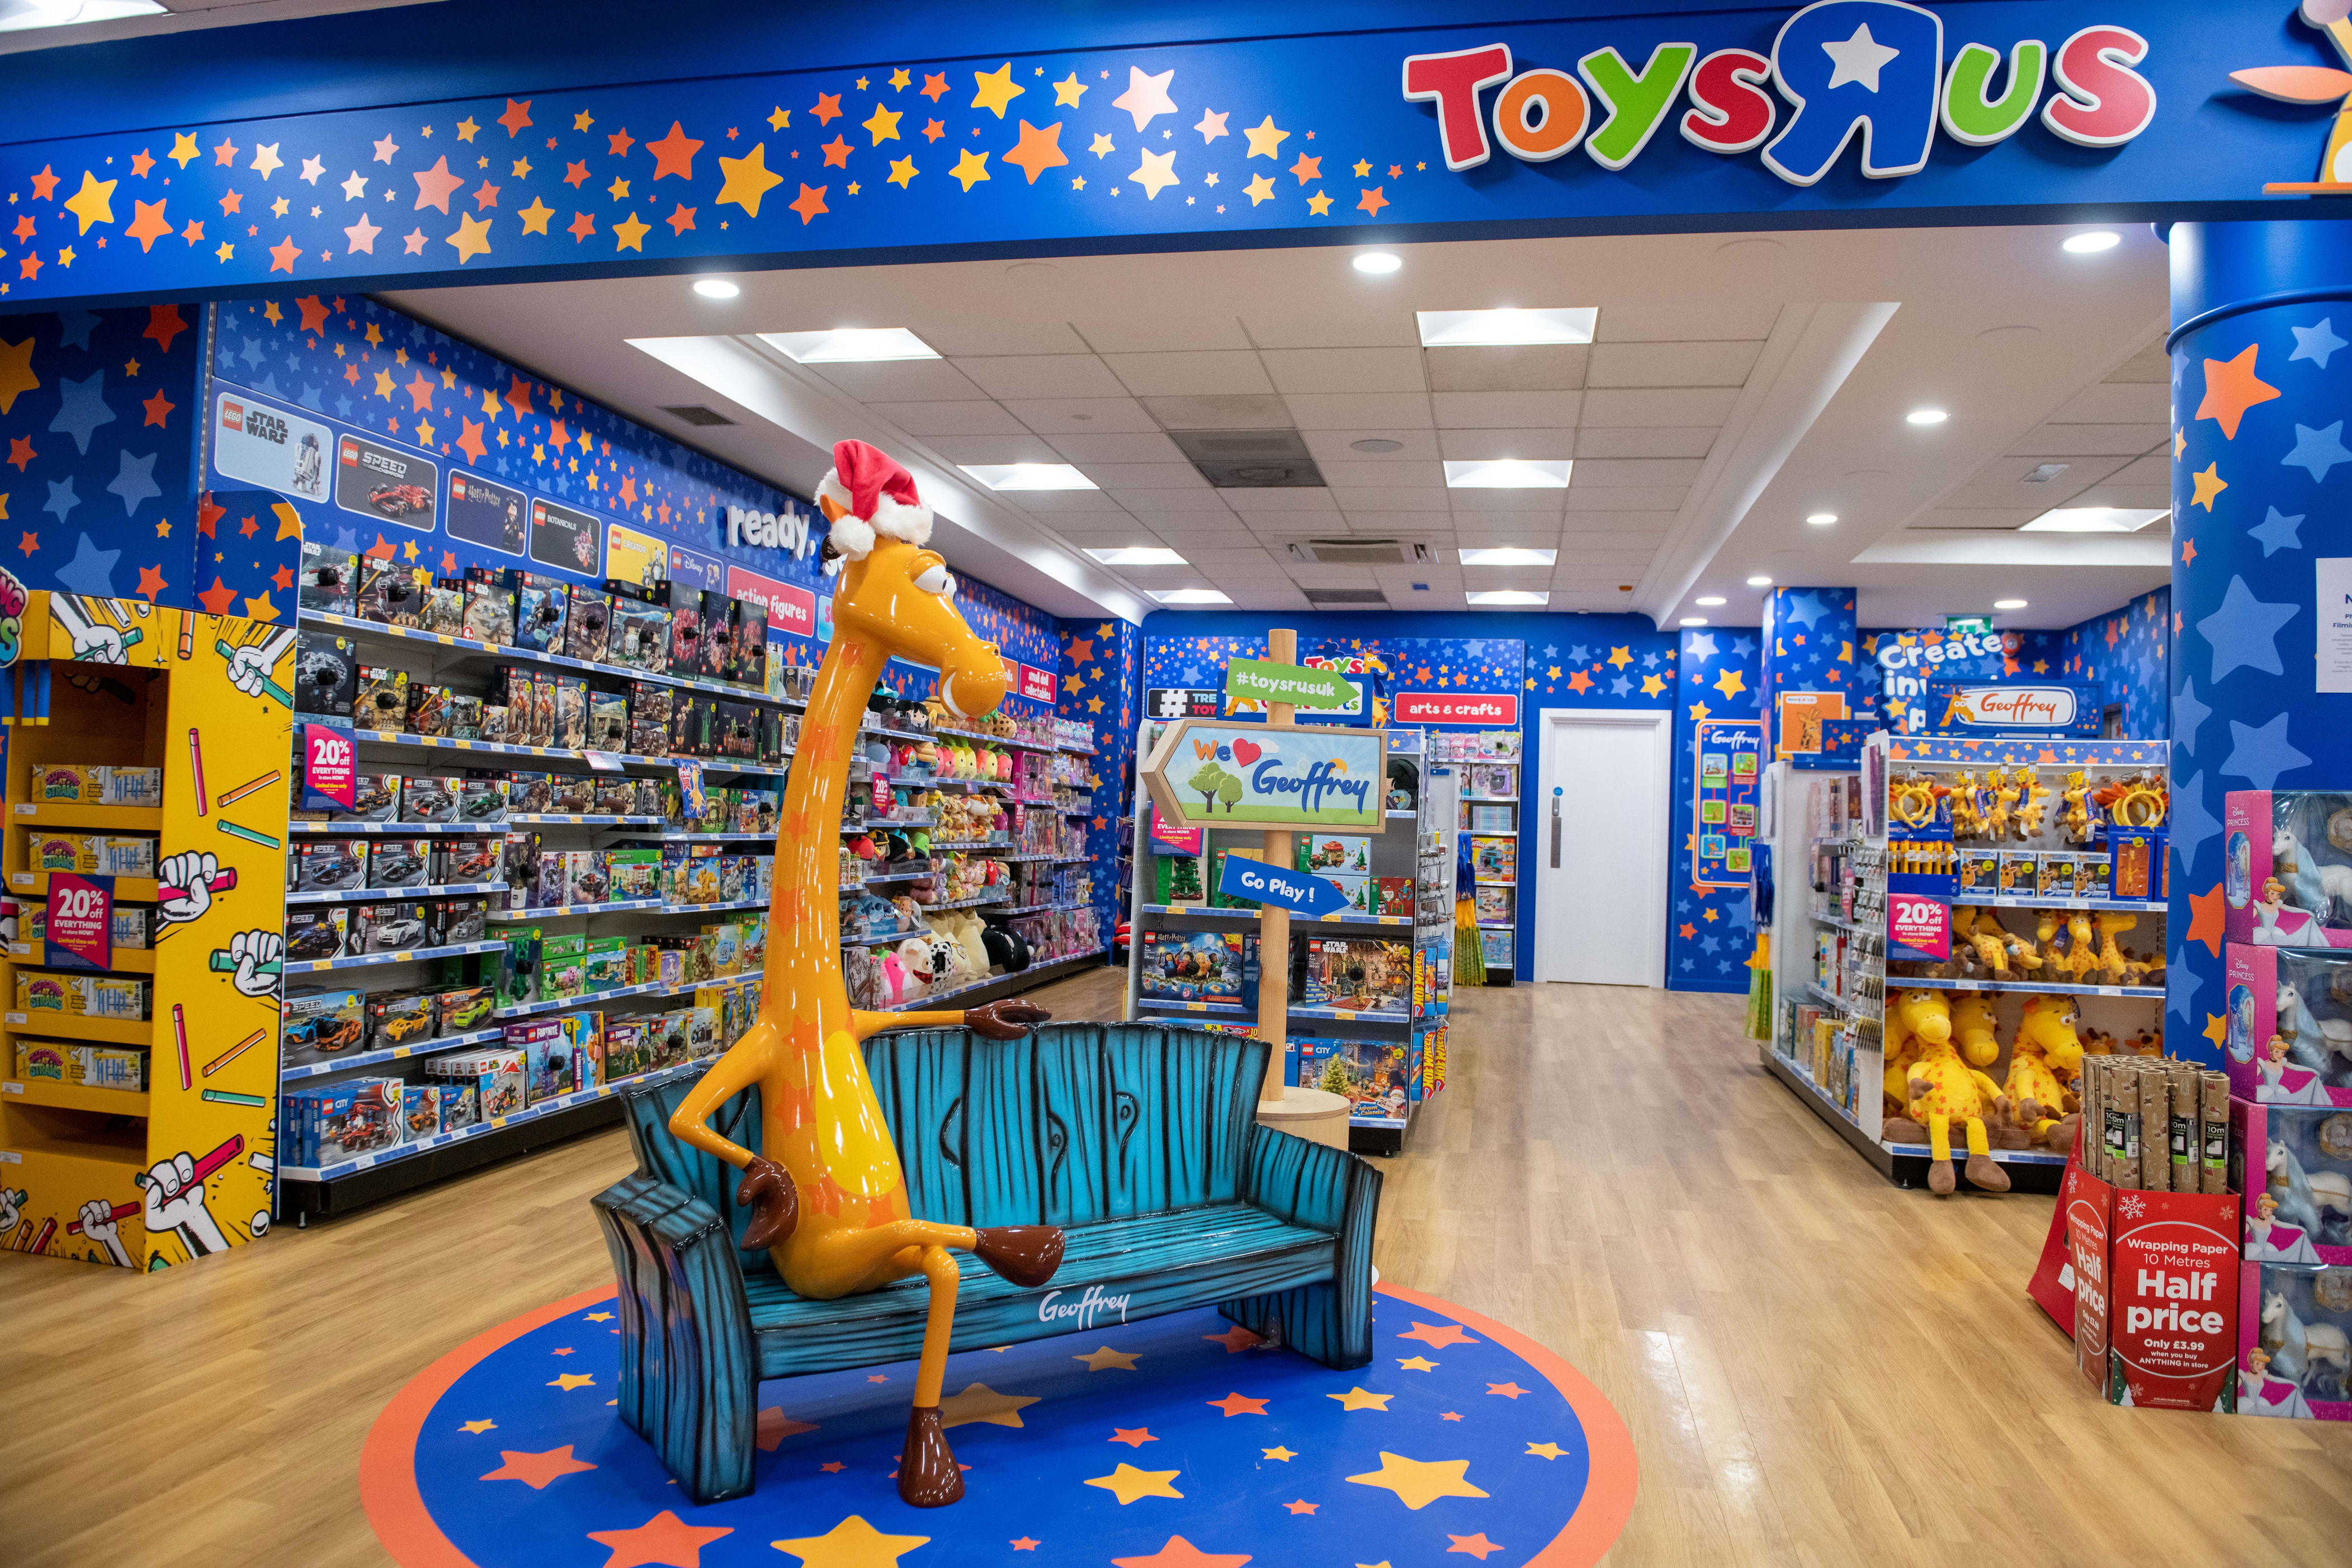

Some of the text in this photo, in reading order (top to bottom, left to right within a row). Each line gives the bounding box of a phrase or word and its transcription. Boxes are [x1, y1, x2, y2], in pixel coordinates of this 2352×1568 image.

[223, 408, 242, 424] LEGO
[247, 410, 288, 434] STAR
[246, 423, 288, 445] WARS
[342, 448, 358, 460] LEGO
[362, 451, 407, 475] SPEED
[379, 467, 405, 479] CHAMPIONS
[453, 483, 465, 494] LEGO
[467, 484, 502, 507] Harry Potter
[534, 510, 577, 531] LEGO BOTANICALS
[612, 536, 646, 554] LEGO CREATOR
[771, 596, 806, 622] figures
[1878, 632, 2004, 669] Create
[1028, 671, 1049, 686] small doll
[1236, 672, 1335, 697] #toysrusuk
[1025, 683, 1051, 701] collectables
[1410, 702, 1502, 716] arts & crafts
[1981, 693, 2057, 722] Geoffrey
[1711, 730, 1760, 750] Geoffrey
[314, 739, 350, 766] 20%
[339, 756, 350, 766] off
[1193, 739, 1369, 815] We Geoffrey
[45, 784, 79, 800] STRAWS
[2232, 806, 2245, 817] Disney
[2227, 818, 2250, 827] PRINCESS
[1241, 871, 1264, 889] Go
[1269, 879, 1305, 903] Play
[56, 888, 103, 918] 20%
[89, 908, 103, 919] off
[1896, 902, 1942, 924] 20%
[1929, 916, 1942, 924] off
[54, 919, 102, 930] EVERYTHING
[1158, 934, 1172, 943] Harry
[1171, 933, 1186, 942] Potter
[2235, 958, 2249, 970] Disney
[2229, 969, 2254, 981] PRINCESS
[30, 994, 63, 1010] STRAWS
[292, 999, 322, 1010] SPEED
[537, 1024, 558, 1039] FORTNITE
[615, 1028, 631, 1038] FORTNITE
[30, 1062, 62, 1079] STRAWS
[336, 1098, 348, 1109] CITY
[2171, 1121, 2186, 1130] 10m
[2070, 1212, 2104, 1240] Wrapping Paper
[2075, 1228, 2098, 1251] 10 Metres
[2127, 1238, 2228, 1254] Wrapping Paper
[2075, 1243, 2101, 1283] Half
[2143, 1253, 2210, 1268] 10 Metres
[2137, 1269, 2217, 1301] Half
[2077, 1276, 2105, 1317] price
[1038, 1284, 1130, 1330] Geoffrey
[2127, 1302, 2223, 1334] price
[2144, 1338, 2204, 1351] Only £3.99
[2139, 1357, 2181, 1366] ANYTHING
